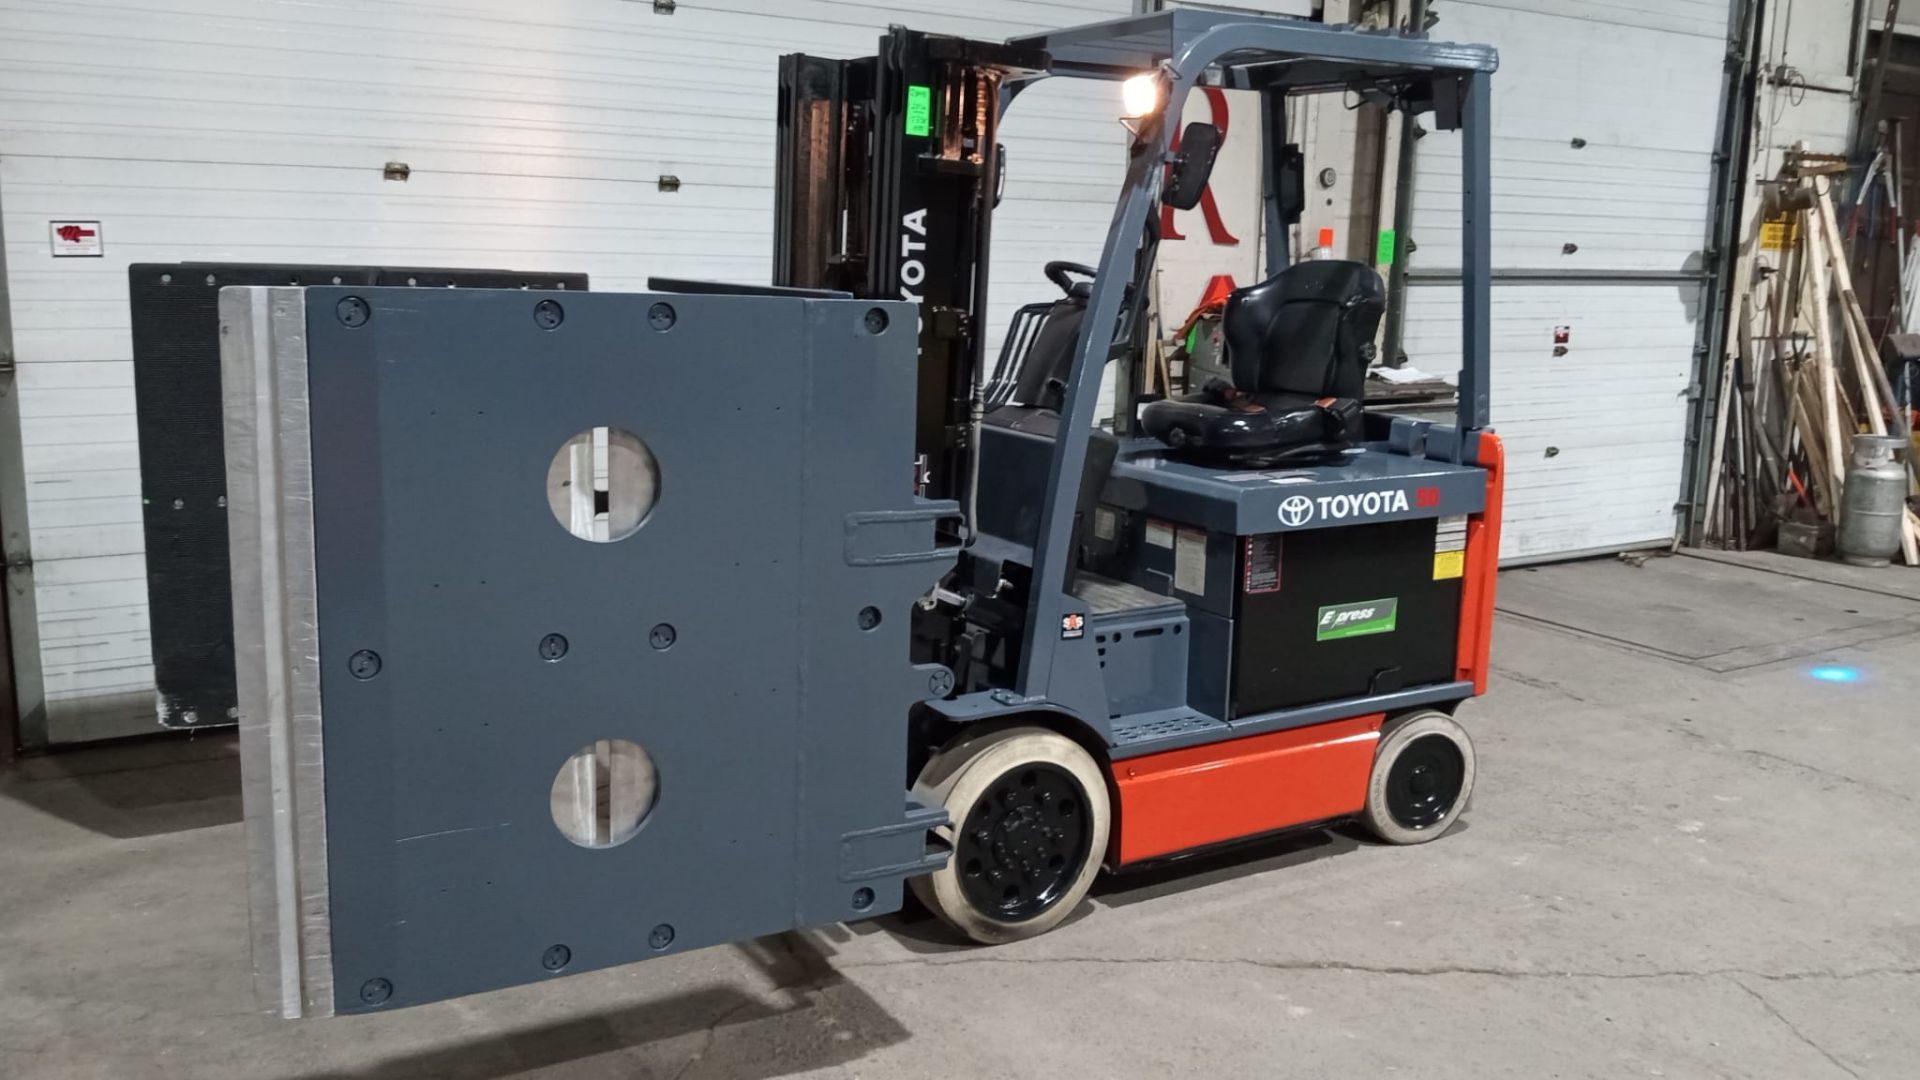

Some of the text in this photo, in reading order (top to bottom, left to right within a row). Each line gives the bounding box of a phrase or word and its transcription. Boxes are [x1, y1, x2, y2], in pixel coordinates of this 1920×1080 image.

[900, 208, 927, 355] YOTA
[1317, 490, 1409, 519] TOYOTA
[1320, 608, 1376, 629] Epress
